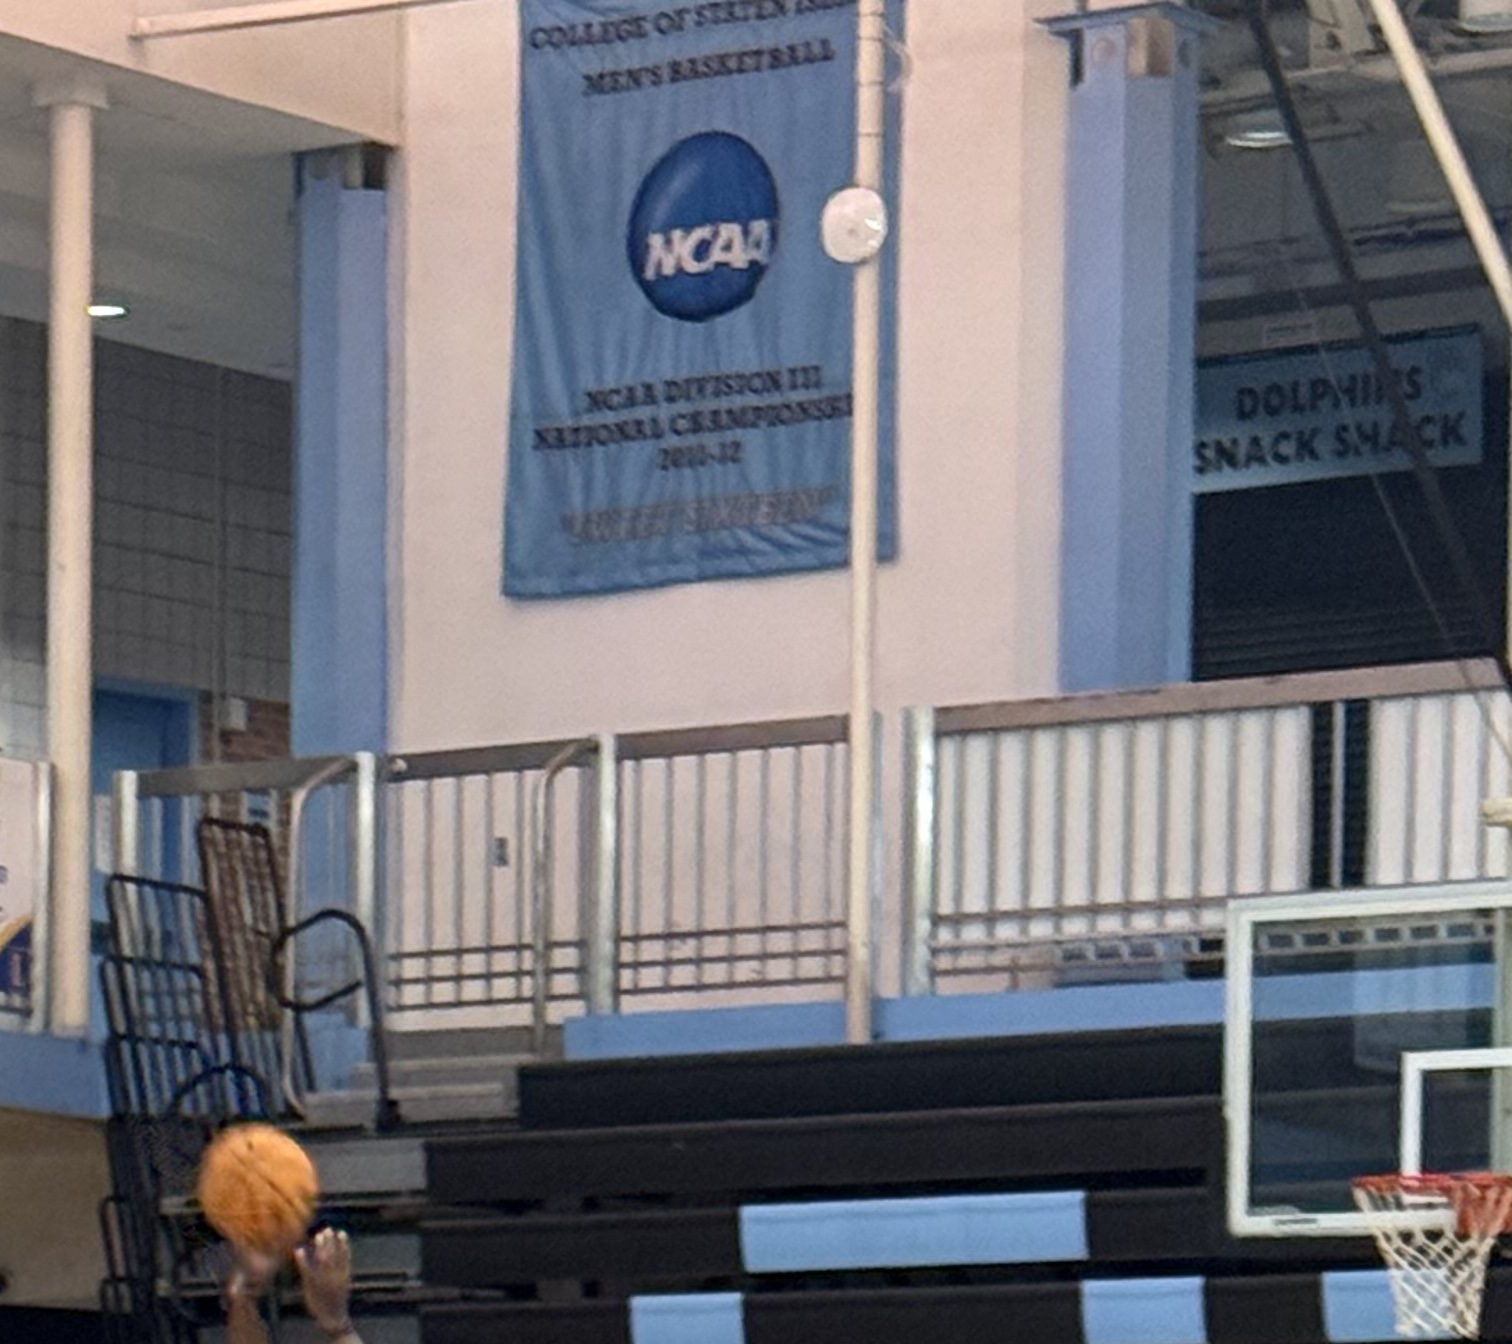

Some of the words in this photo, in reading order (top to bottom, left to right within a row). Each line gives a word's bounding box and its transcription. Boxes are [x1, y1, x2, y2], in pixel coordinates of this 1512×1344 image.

[529, 15, 649, 50] COLLEGE
[653, 9, 688, 36] OF
[667, 38, 836, 83] BASKETBALL
[642, 218, 770, 281] NCAA
[584, 381, 659, 414] NCAA
[663, 369, 783, 404] DIVISION
[787, 364, 822, 390] III
[532, 417, 665, 450] NATIONAL
[669, 391, 854, 437] CHAMPIONSHI
[1193, 426, 1322, 476] SNACK
